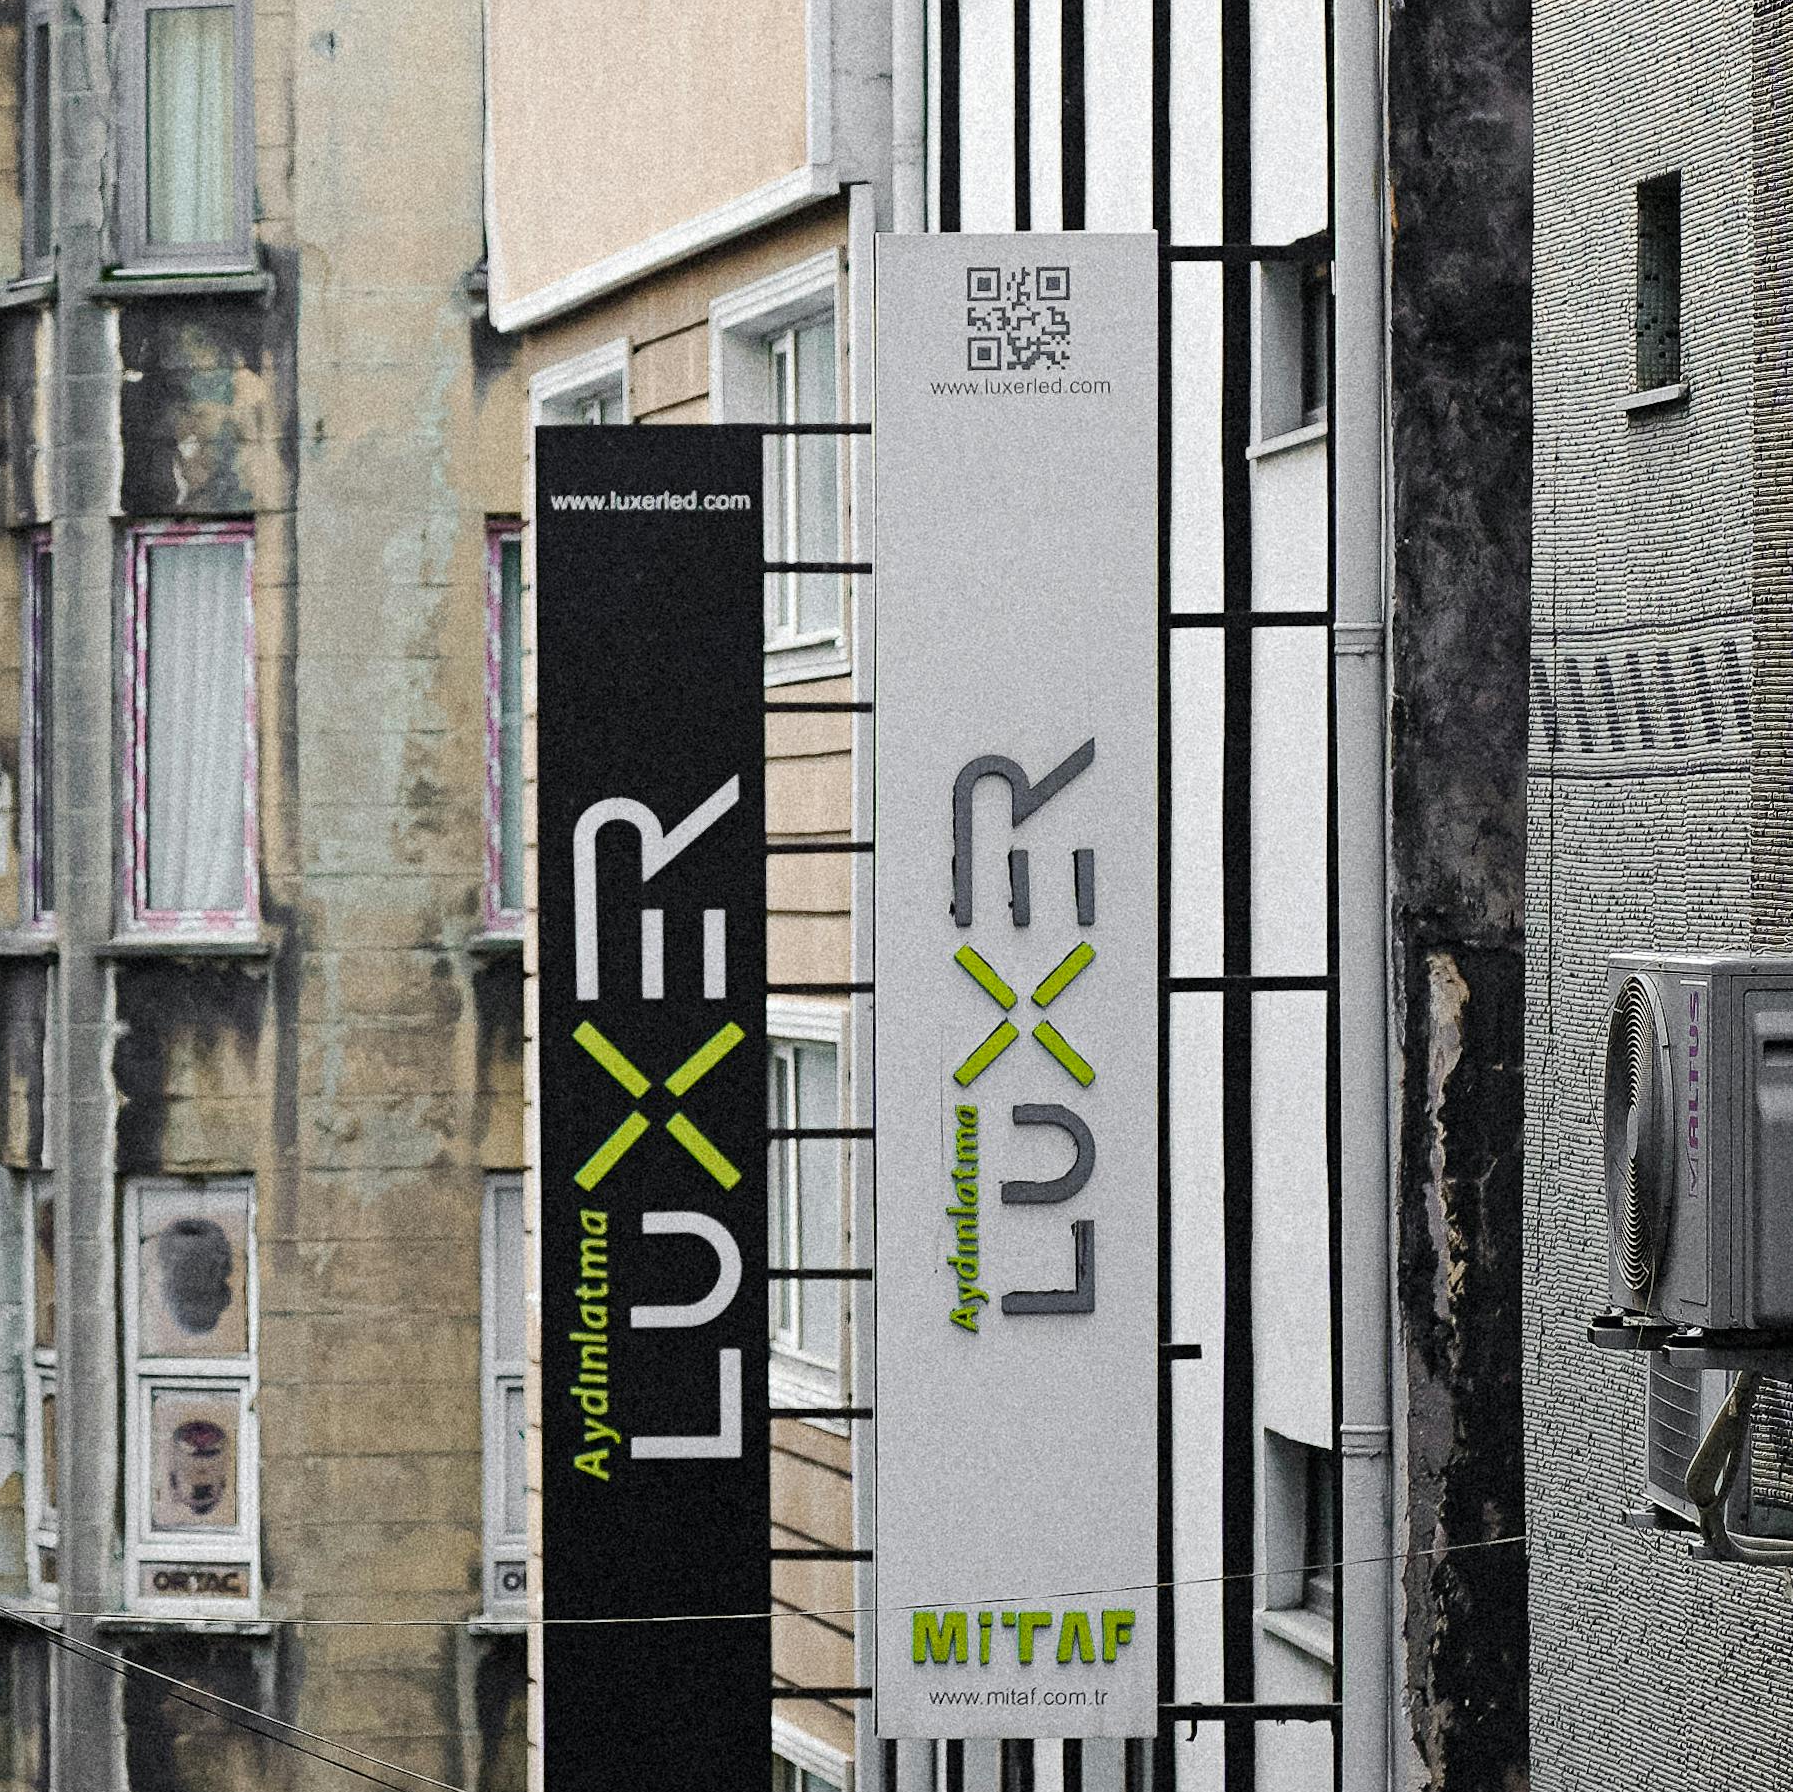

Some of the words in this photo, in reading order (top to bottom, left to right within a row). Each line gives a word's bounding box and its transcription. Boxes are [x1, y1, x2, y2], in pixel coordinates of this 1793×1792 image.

[550, 490, 751, 511] www.luxerled.com
[930, 378, 1111, 395] www.luxerled.com
[572, 773, 744, 1460] LUXER
[953, 736, 1097, 1315] LUXER
[948, 1104, 981, 1334] Aydınlatma
[572, 1208, 622, 1480] Aydınlatma
[929, 1686, 1108, 1708] www.mitaf.com.tr
